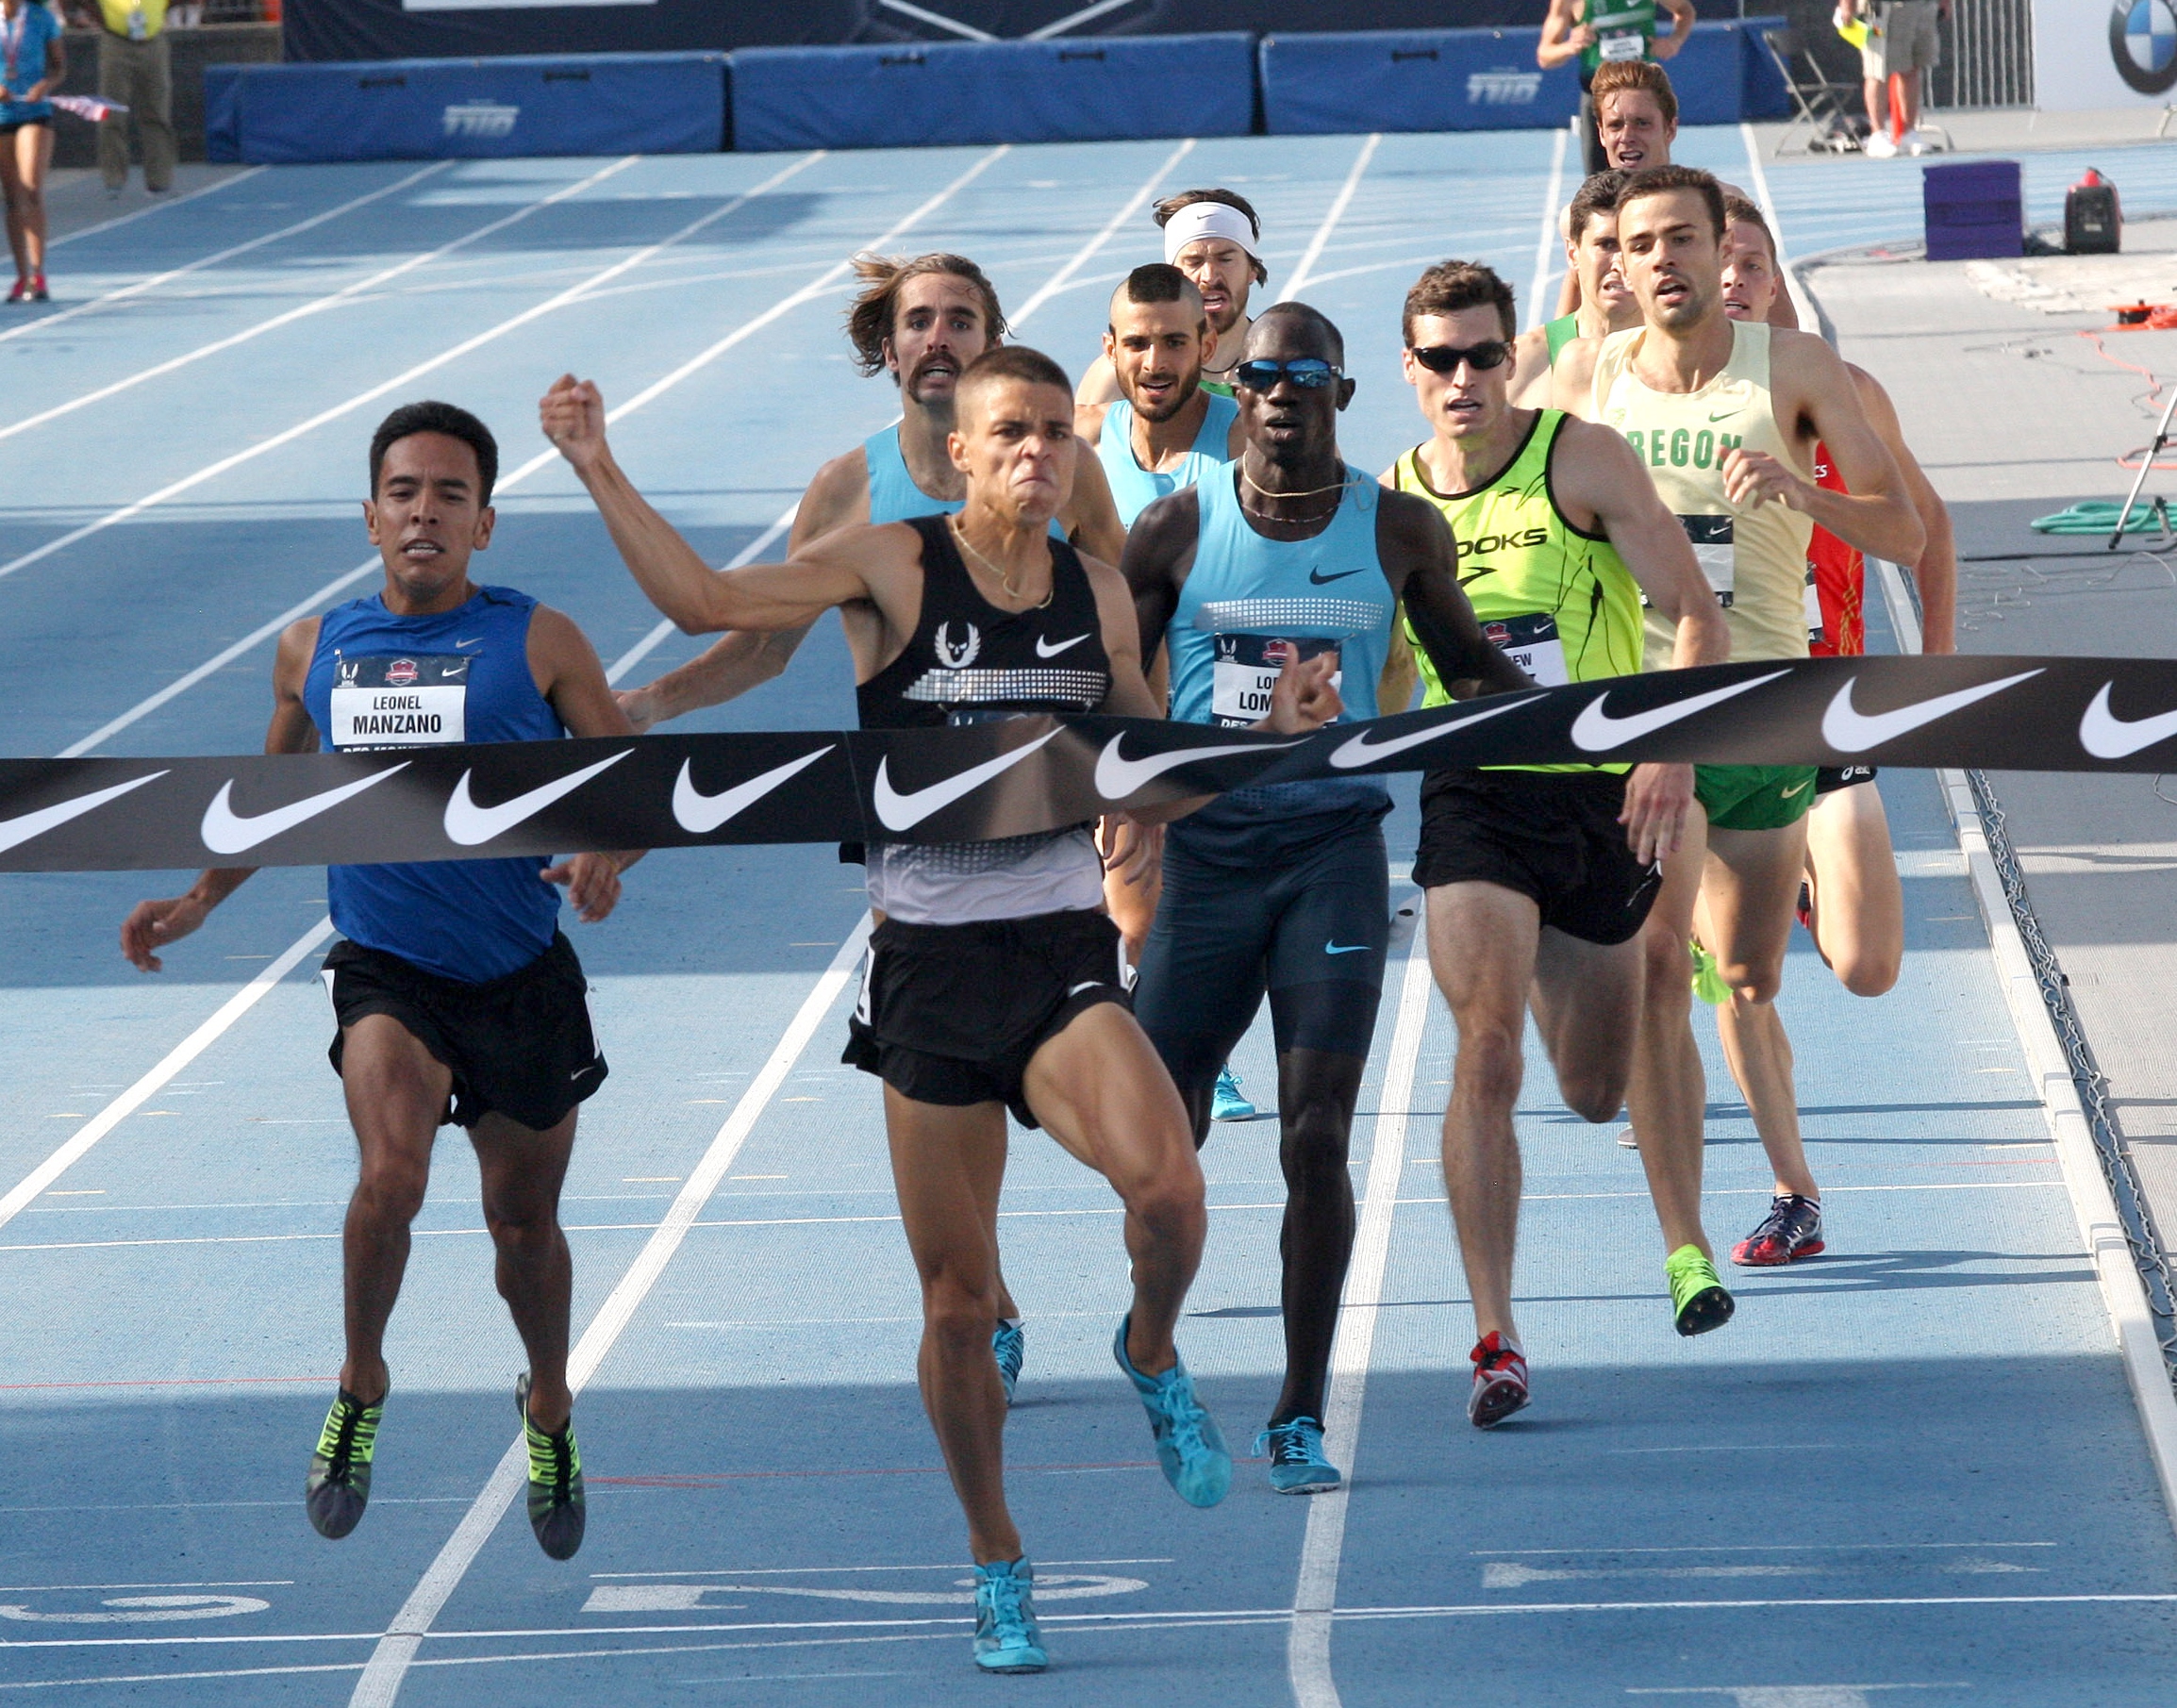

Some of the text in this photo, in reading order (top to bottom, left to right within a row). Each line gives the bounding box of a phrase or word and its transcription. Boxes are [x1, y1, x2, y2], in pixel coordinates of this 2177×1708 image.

[1626, 428, 1743, 471] REGON
[1455, 527, 1549, 558] OOKS
[374, 695, 422, 710] LEONEL
[1238, 691, 1272, 712] LOM
[353, 714, 441, 735] MANZANO
